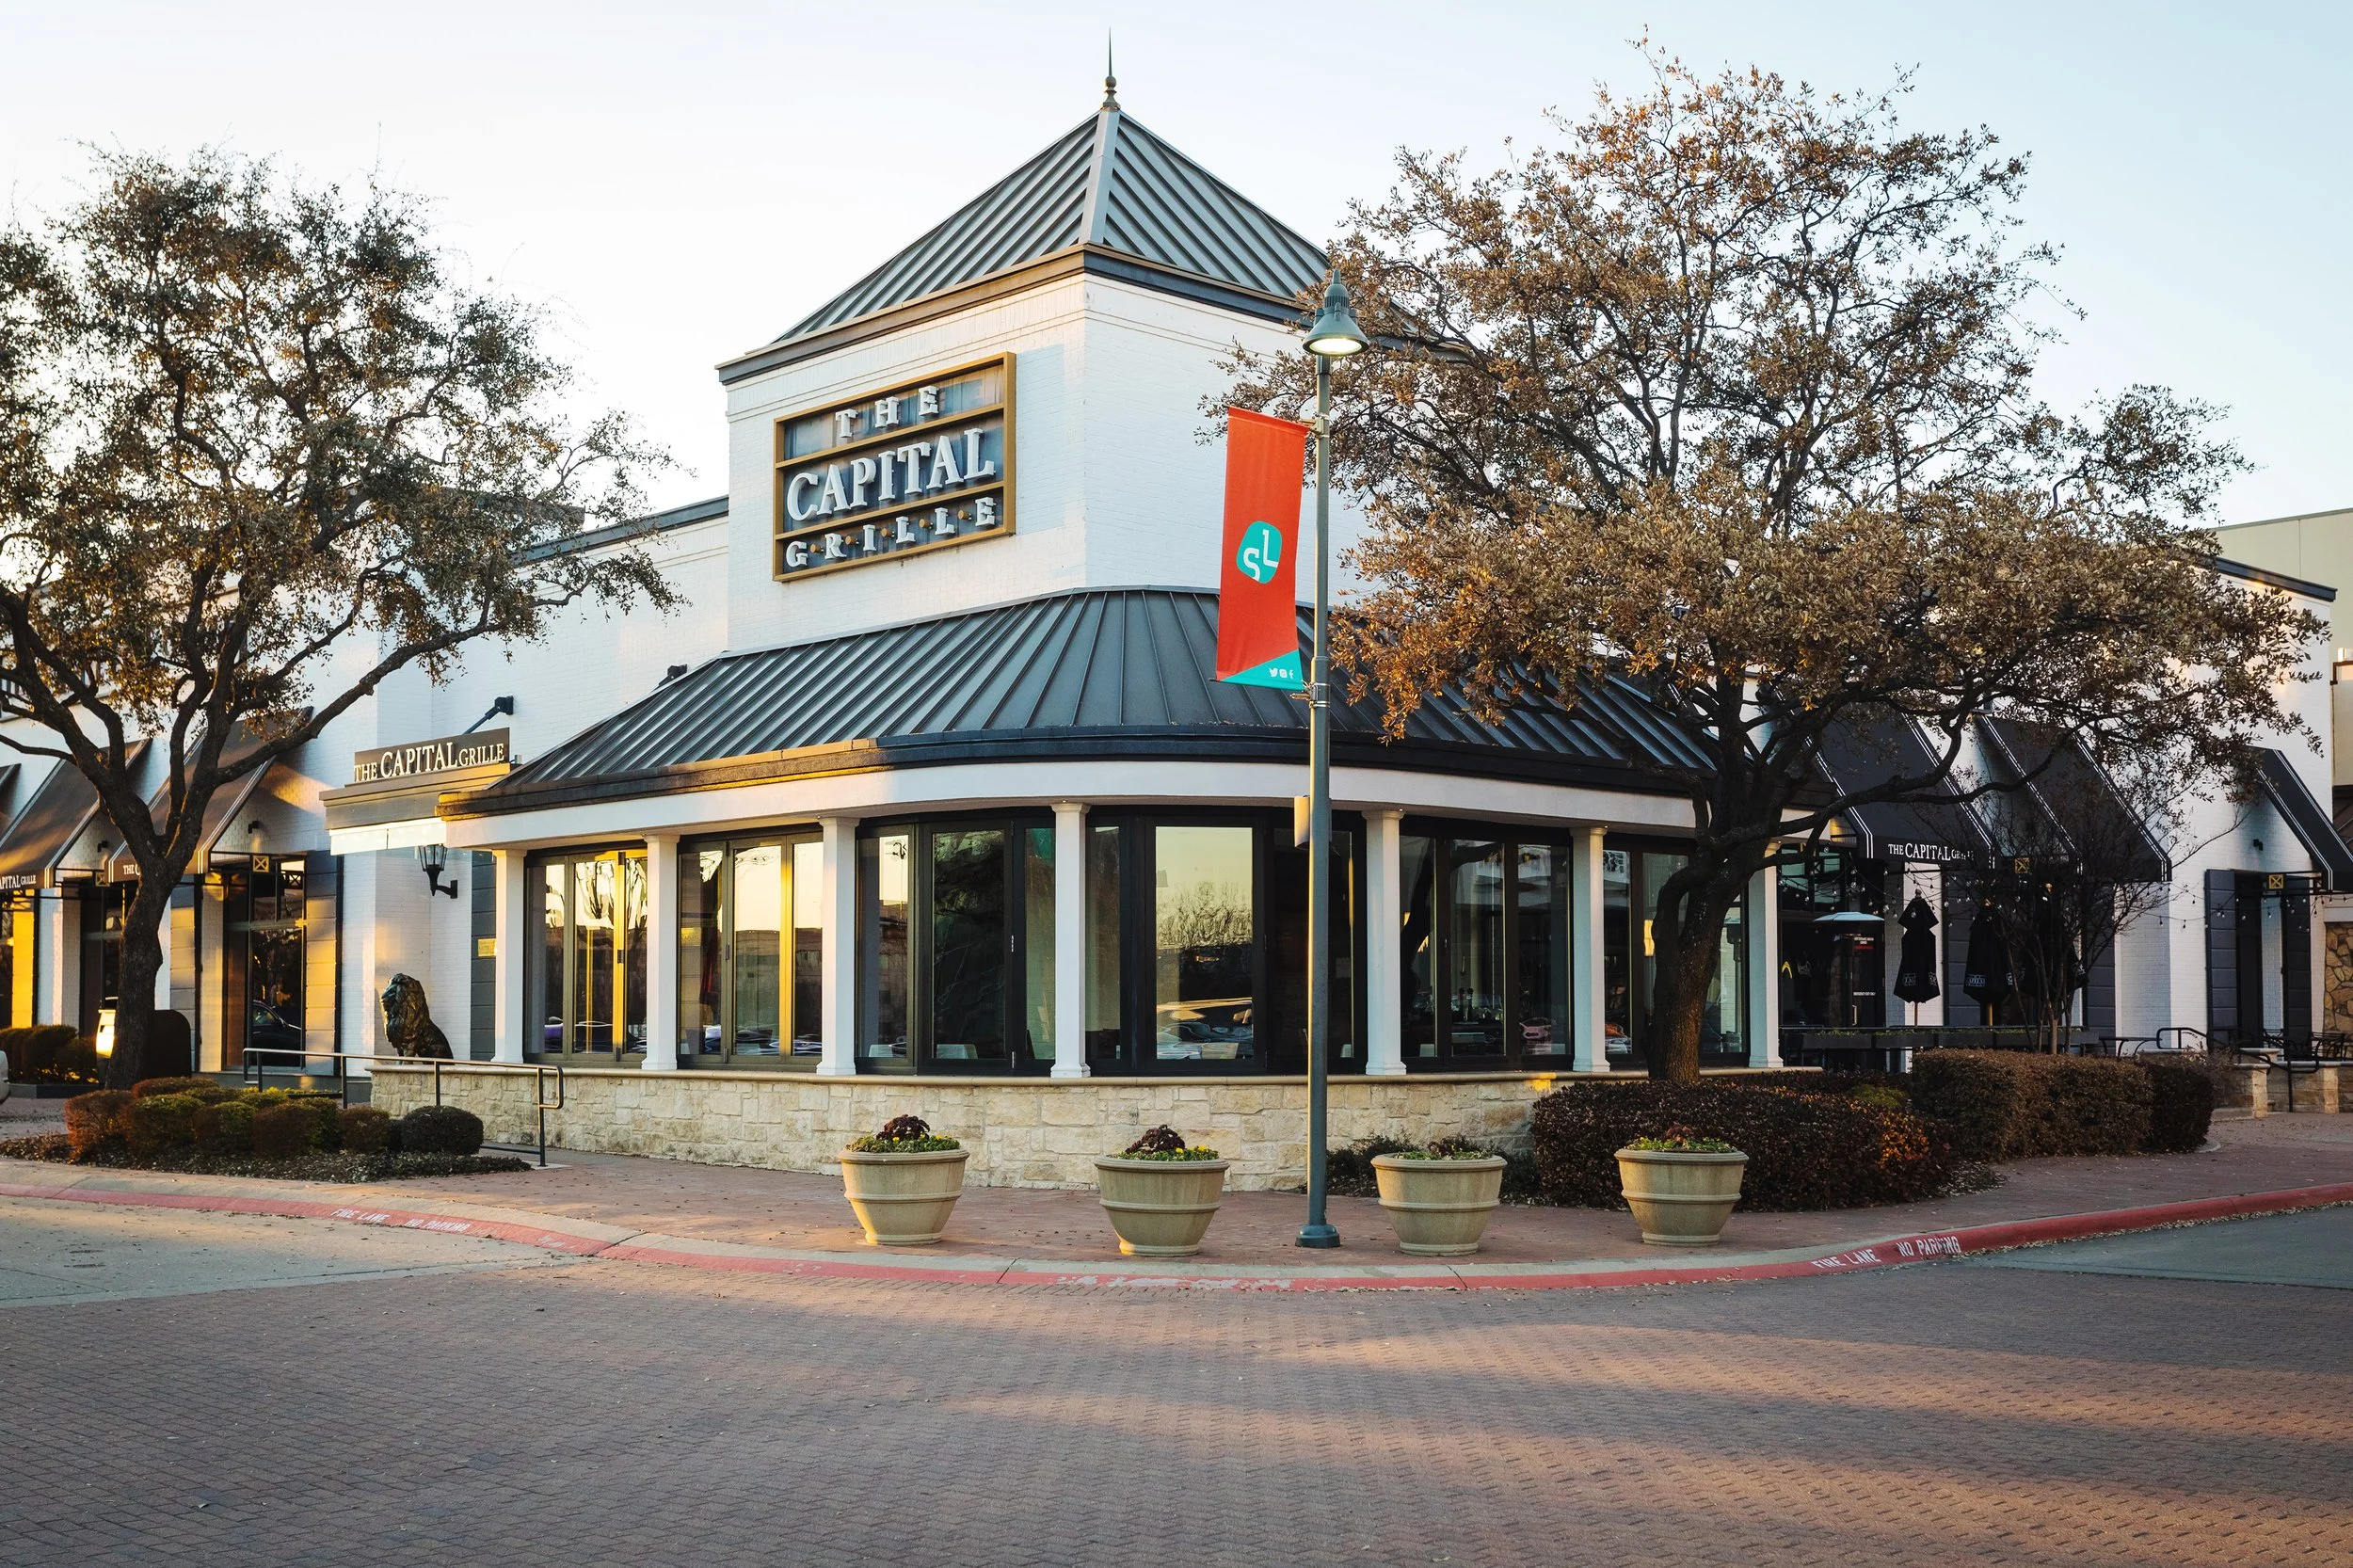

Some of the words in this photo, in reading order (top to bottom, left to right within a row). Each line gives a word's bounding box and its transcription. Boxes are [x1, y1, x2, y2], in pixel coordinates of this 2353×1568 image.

[836, 385, 939, 438] THE
[787, 427, 997, 521] CAPITAL
[354, 763, 378, 782] THE
[380, 742, 458, 778] CAPITAL
[458, 743, 504, 767] GRILLE
[1888, 843, 1904, 856] THE
[1905, 842, 1951, 861] CAPITAL
[0, 874, 21, 889] PITAL
[122, 863, 136, 875] THE
[330, 1208, 360, 1219] FIRE
[357, 1212, 391, 1223] LANE
[405, 1218, 425, 1227] NO
[424, 1220, 472, 1232] PARKING
[1811, 1256, 1847, 1269] FIRE
[1845, 1248, 1882, 1264] LANE
[1896, 1241, 1914, 1256] NO
[1915, 1235, 1962, 1256] PARKING
